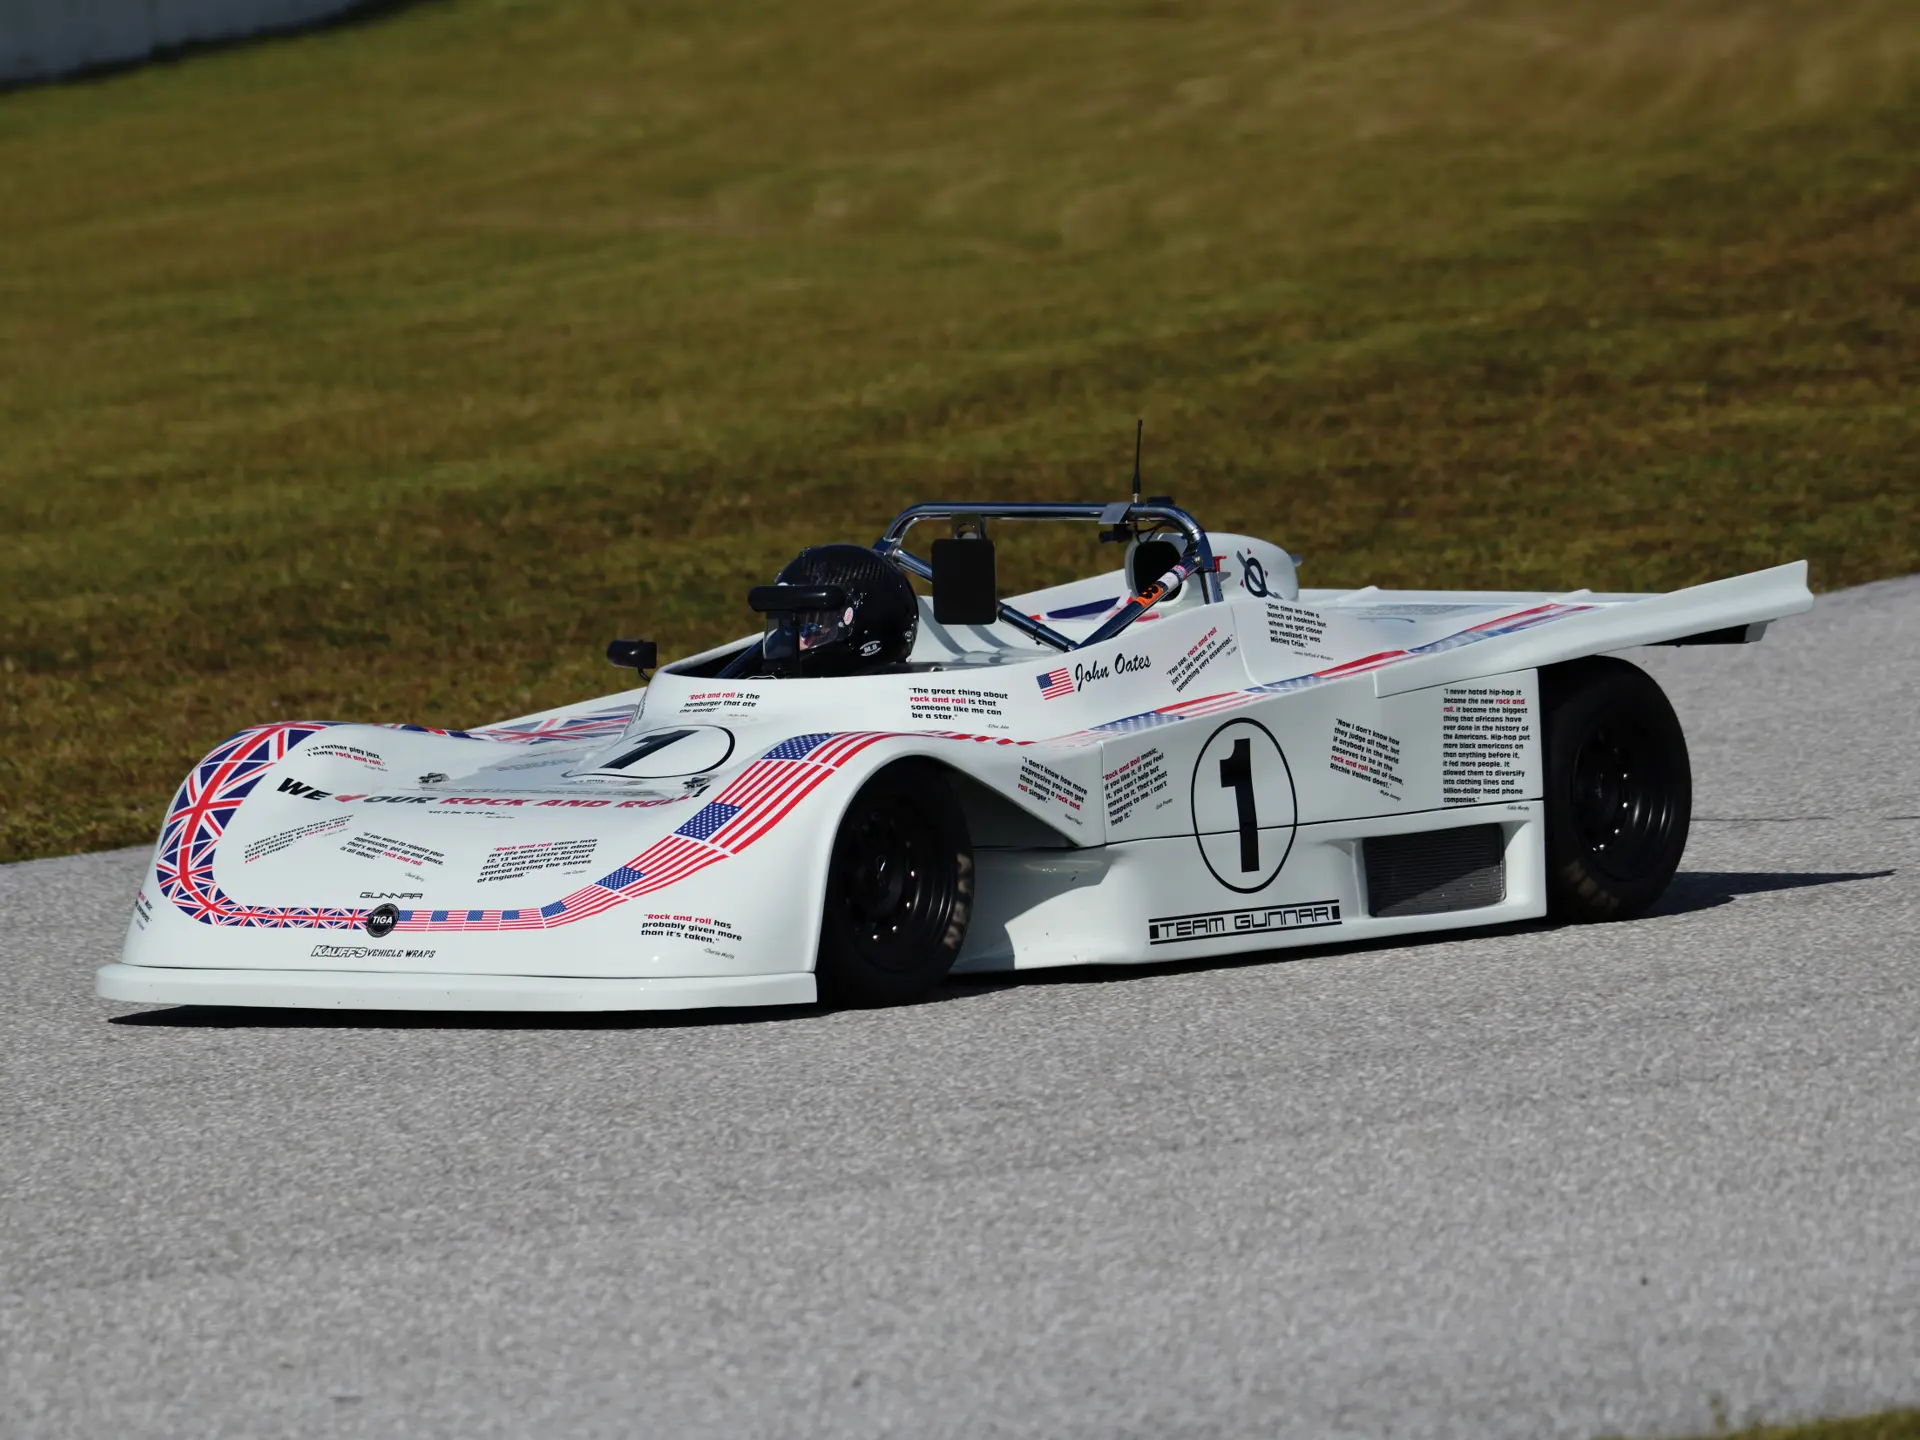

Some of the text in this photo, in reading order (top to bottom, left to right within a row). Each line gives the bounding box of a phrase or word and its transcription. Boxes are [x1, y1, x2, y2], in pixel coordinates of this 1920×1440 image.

[1187, 645, 1198, 657] rock
[1198, 635, 1208, 647] and
[1208, 627, 1217, 637] roll
[1075, 653, 1151, 692] John Oates
[1176, 668, 1200, 692] something
[1199, 658, 1210, 670] very
[1185, 661, 1194, 671] life
[958, 689, 981, 697] thing
[599, 730, 700, 769] 1
[1372, 730, 1387, 741] know
[1389, 737, 1400, 745] how
[1029, 760, 1043, 771] don't
[1044, 767, 1059, 779] know
[1060, 775, 1072, 786] how
[1073, 784, 1087, 795] more
[1110, 779, 1120, 789] you
[1121, 773, 1130, 781] like
[1143, 760, 1152, 770] you
[1153, 753, 1164, 763] feel
[1113, 787, 1123, 796] you
[1138, 772, 1149, 781] help
[1150, 766, 1159, 774] but
[1119, 763, 1129, 773] and
[277, 777, 332, 800] WE
[364, 795, 437, 804] OUR
[440, 797, 534, 807] ROCK
[534, 800, 612, 808] AND
[1018, 784, 1028, 792] roll
[1020, 774, 1033, 785] than
[1034, 782, 1049, 795] being
[1056, 794, 1067, 804] rock
[1069, 801, 1080, 810] and
[1022, 766, 1084, 803] expressive you can get
[1108, 797, 1122, 808] move
[1154, 771, 1167, 782] what
[1109, 800, 1132, 817] happens
[1220, 738, 1259, 873] 1
[1111, 816, 1123, 826] help
[373, 916, 393, 924] TIGA
[642, 922, 742, 941] probably given more
[714, 920, 731, 929] has
[1160, 906, 1329, 938] TEAM GUNNAR
[311, 945, 436, 958] KAUFF'S VEHICLE WRAPS
